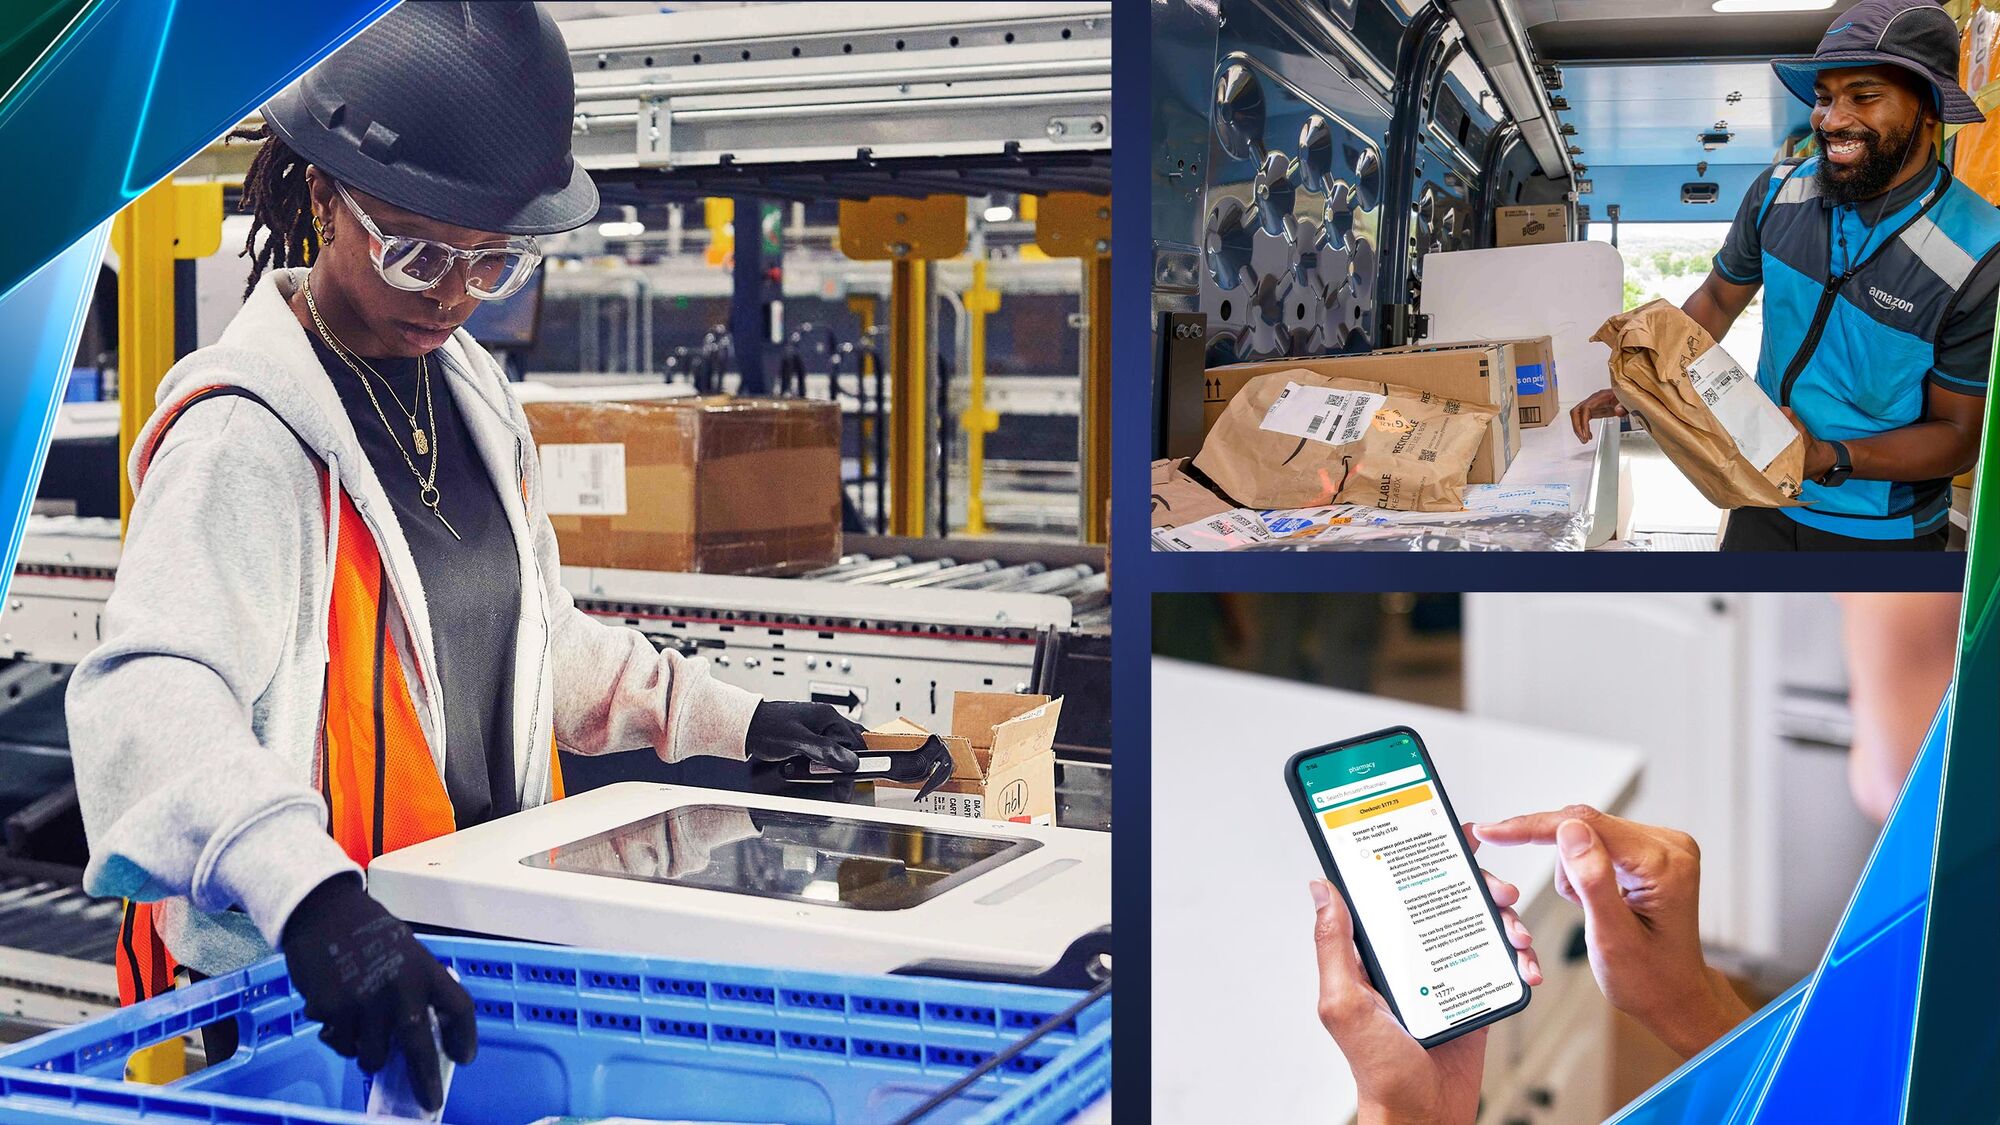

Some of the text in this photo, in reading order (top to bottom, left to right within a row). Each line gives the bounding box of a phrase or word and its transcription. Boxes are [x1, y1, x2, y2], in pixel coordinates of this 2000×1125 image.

[1522, 223, 1545, 236] Bounty
[1869, 286, 1914, 313] amazon
[1392, 419, 1420, 454] RECYCLALE
[1377, 473, 1392, 509] CLABLE
[1349, 761, 1376, 773] pharmacy
[1327, 782, 1386, 801] Search Amazon Pharmacy
[1360, 806, 1380, 814] Checkout:
[1373, 845, 1393, 853] Insurance
[1414, 832, 1431, 840] available
[1397, 844, 1417, 853] contacted
[1428, 835, 1447, 844] prescriber
[1390, 862, 1408, 870] Arkansas
[1430, 849, 1449, 857] insurance
[1431, 857, 1446, 865] process
[1411, 871, 1428, 879] business
[1411, 878, 1430, 886] recognize
[1404, 894, 1427, 904] Contacting
[1437, 884, 1457, 894] prescriber
[1452, 916, 1474, 926] medication
[1423, 937, 1438, 945] without
[1454, 949, 1469, 957] Contact
[1470, 942, 1488, 951] Customer
[1439, 997, 1456, 1006] Includes
[1442, 1000, 1469, 1012] manufacturer
[1470, 993, 1485, 1001] coupon
[1456, 1007, 1471, 1015] coupon
